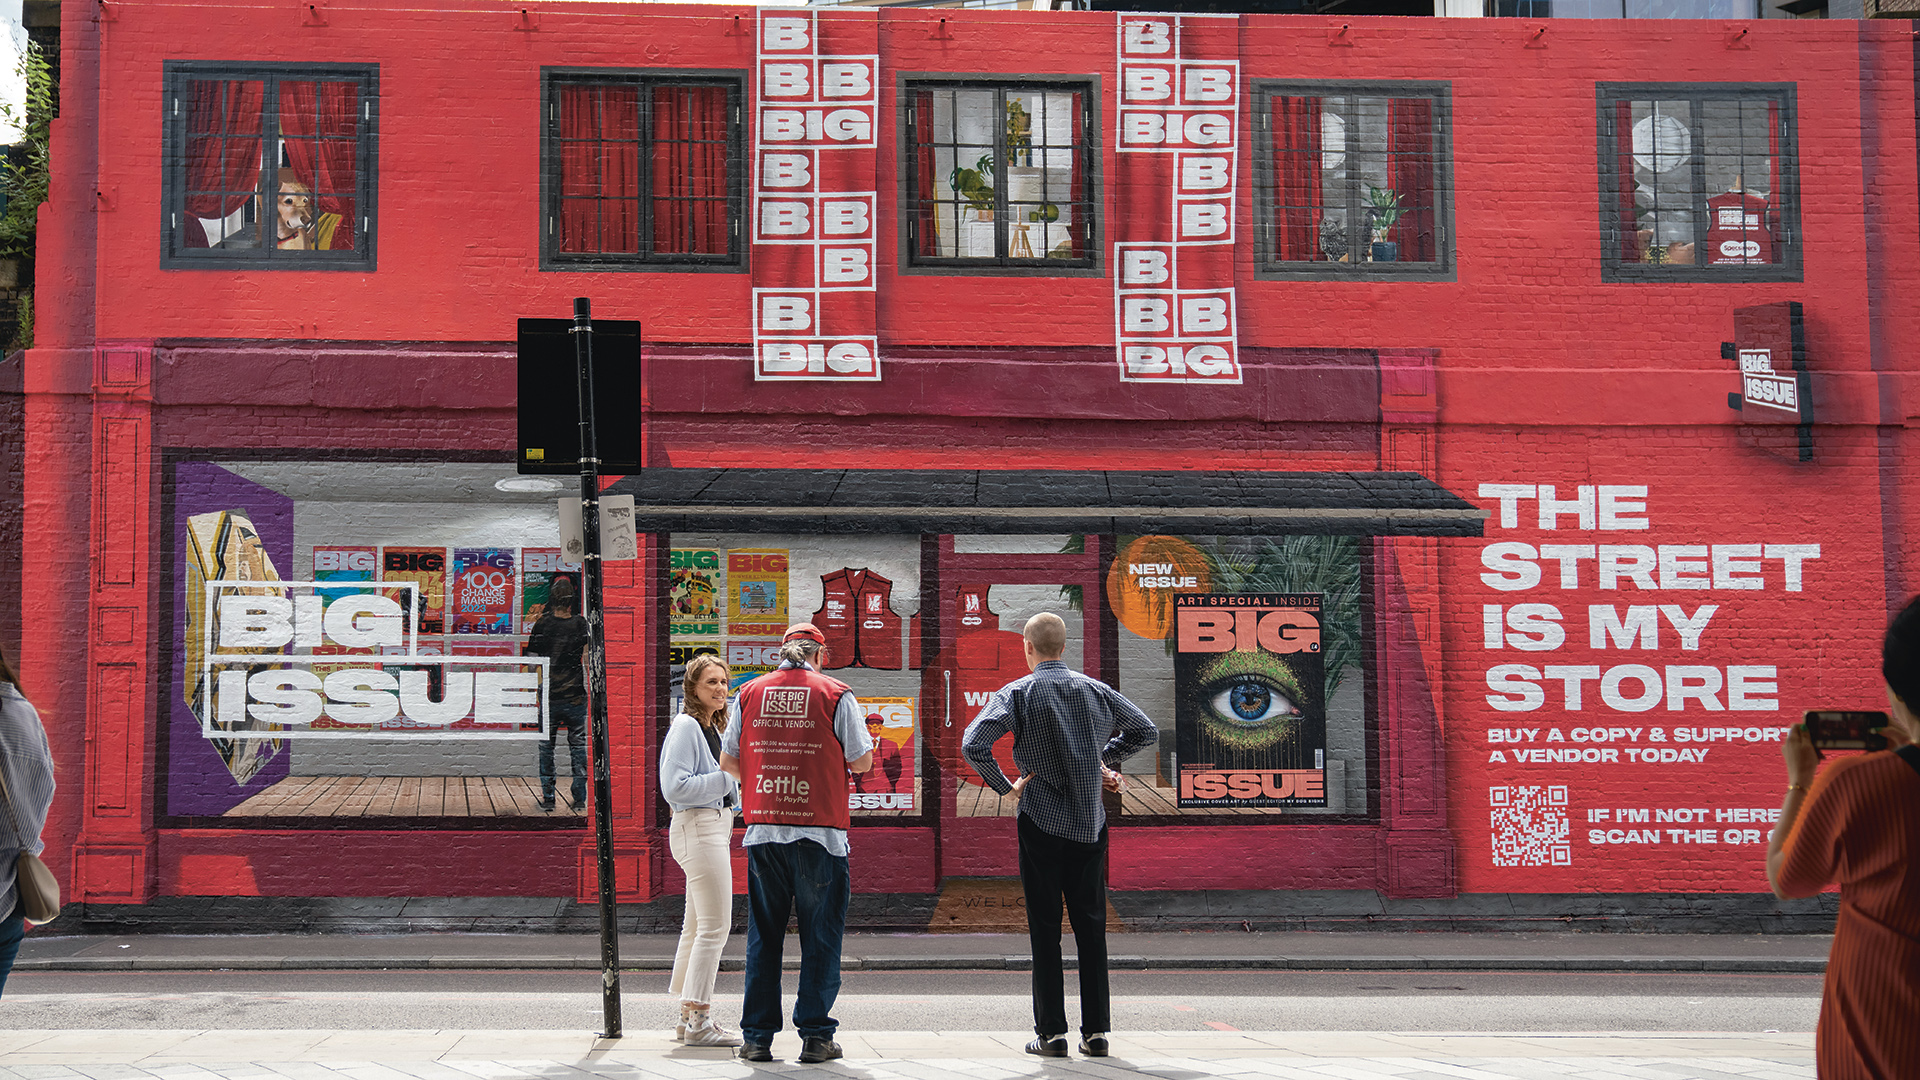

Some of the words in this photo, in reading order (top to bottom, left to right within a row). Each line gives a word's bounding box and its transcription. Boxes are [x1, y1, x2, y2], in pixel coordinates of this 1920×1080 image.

[764, 17, 810, 50] B
[1125, 21, 1171, 53] B
[764, 63, 810, 96] B
[823, 63, 870, 97] B
[1125, 67, 1171, 100] B
[1184, 68, 1232, 100] B
[763, 109, 871, 140] BIG
[1123, 113, 1230, 144] BIG
[763, 153, 811, 187] B
[1182, 157, 1229, 189] B
[761, 201, 810, 235] B
[823, 201, 869, 234] B
[1182, 204, 1227, 237] B
[823, 248, 869, 282] B
[1123, 250, 1169, 284] B
[762, 297, 811, 330] B
[1124, 298, 1169, 332] B
[1182, 298, 1227, 332] B
[763, 342, 872, 373] BIG
[1125, 345, 1234, 376] BIG
[1741, 354, 1770, 372] BIG
[1746, 378, 1795, 405] ISSUE
[1478, 483, 1649, 530] THE
[315, 551, 375, 571] BIG
[385, 554, 444, 571] BIG
[524, 553, 581, 571] BIG
[729, 554, 788, 572] BIG
[1129, 563, 1173, 575] NEW
[1480, 541, 1821, 591] STREET
[461, 571, 506, 589] 100
[461, 588, 506, 597] CHANGE
[1139, 576, 1197, 588] ISSUE
[461, 596, 506, 605] MAKERS
[461, 604, 486, 612] 2023
[1177, 597, 1204, 606] ART
[1210, 597, 1270, 606] SPECIAL
[1275, 597, 1320, 606] INSIDE
[218, 594, 403, 648] BIG
[729, 624, 788, 635] ISSUE
[1177, 611, 1320, 654] BIG
[1483, 603, 1566, 651] IS
[1588, 604, 1720, 650] MY
[217, 669, 538, 724] ISSUE
[768, 691, 788, 700] THE
[788, 691, 805, 701] BIG
[1485, 664, 1779, 712] STORE
[766, 700, 804, 713] ISSUE
[752, 719, 783, 728] OFFICIAL
[785, 720, 816, 728] VENDOR
[1488, 728, 1540, 742] BUY
[1546, 728, 1565, 742] A
[1571, 728, 1643, 742] COPY
[1648, 728, 1668, 742] &
[1488, 750, 1507, 763] A
[1512, 748, 1619, 763] VENDOR
[1624, 748, 1710, 763] TODAY
[755, 774, 810, 795] Zettle
[1181, 774, 1324, 799] ISSUE
[775, 795, 783, 803] by
[783, 795, 809, 803] PayPal
[1587, 808, 1610, 823] IF
[1616, 808, 1649, 823] I'M
[1655, 808, 1709, 823] NOT
[1715, 808, 1782, 823] HERE
[1588, 829, 1660, 844] SCAN
[1666, 829, 1717, 844] THE
[1723, 829, 1760, 845] QR
